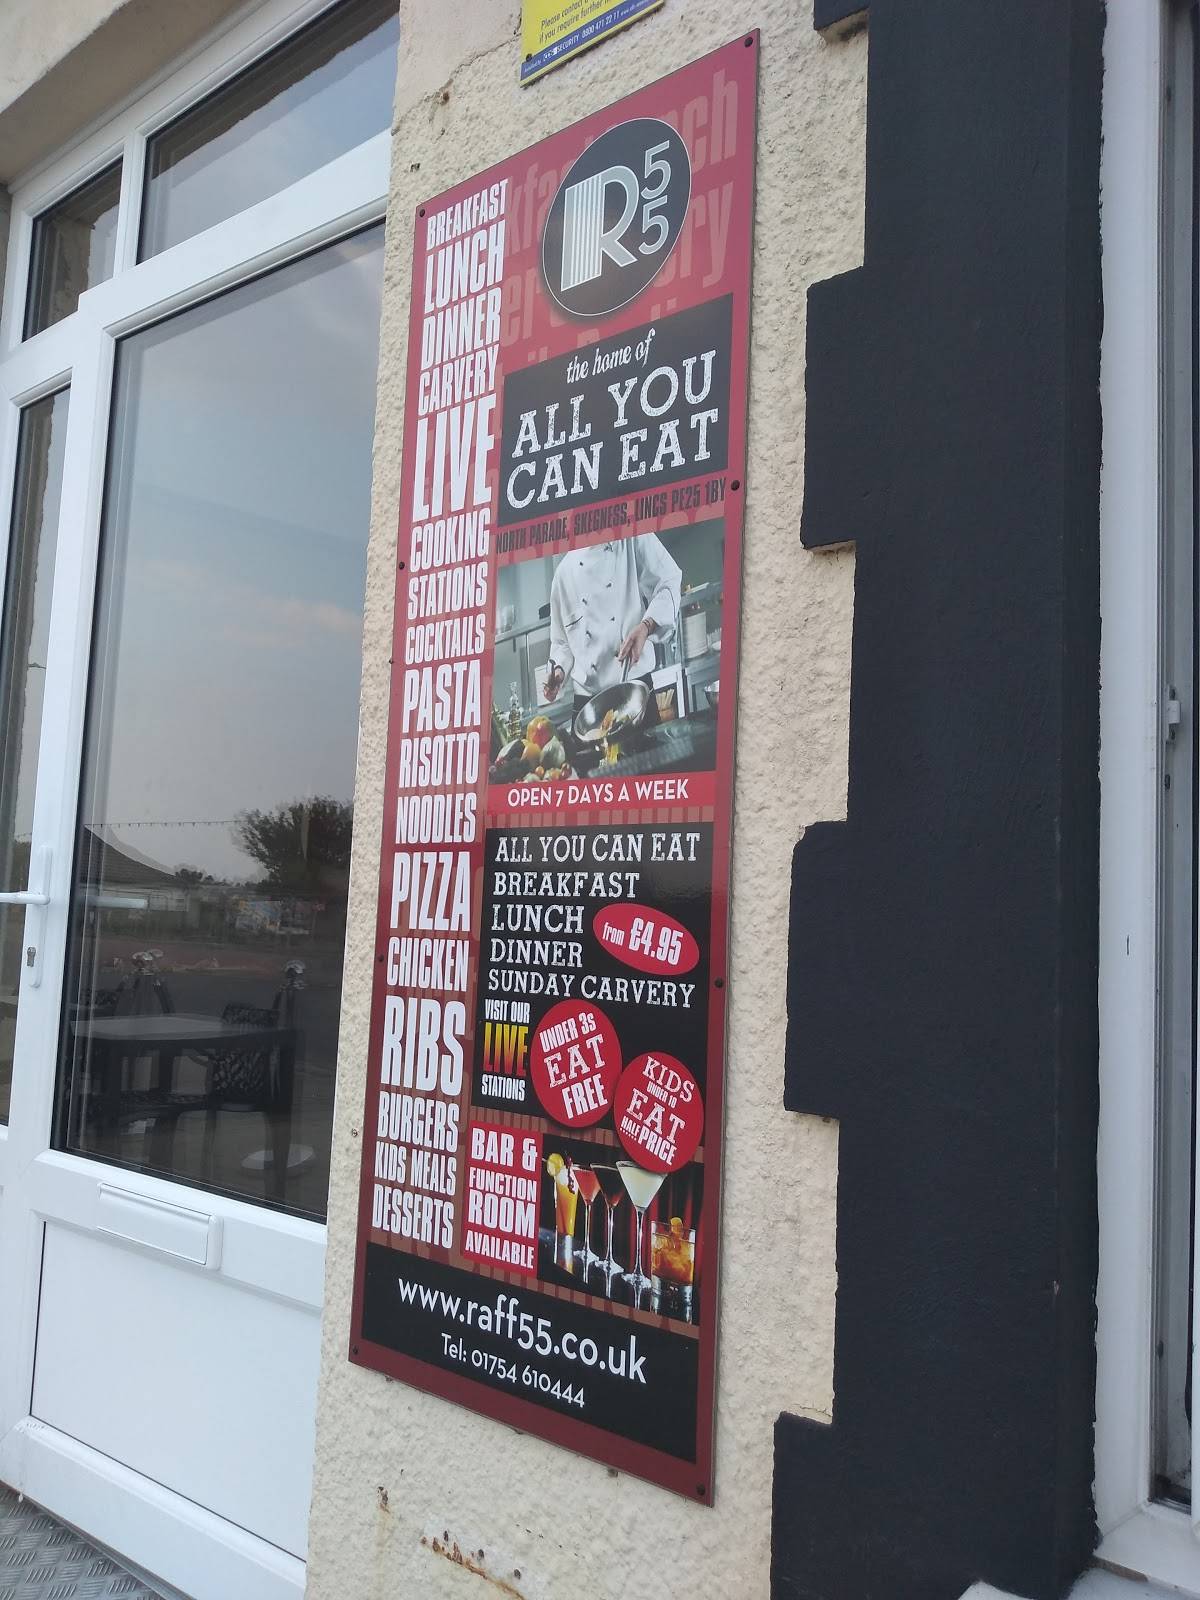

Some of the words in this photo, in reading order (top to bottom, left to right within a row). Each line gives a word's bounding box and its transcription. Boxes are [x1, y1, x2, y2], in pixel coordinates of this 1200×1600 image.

[557, 34, 580, 53] SECURITY
[426, 178, 508, 250] BREAKFAST
[424, 219, 505, 314] LUNCH
[421, 287, 502, 371] DINNER
[566, 356, 589, 384] the
[592, 346, 631, 376] home
[635, 328, 656, 368] of
[418, 343, 500, 416] CARVERY
[511, 394, 592, 458] ALL
[607, 350, 716, 428] YOU
[412, 393, 497, 522] LIVE
[506, 441, 604, 509] CAN
[618, 408, 719, 481] EAT
[410, 508, 491, 573] COOKING
[496, 526, 527, 554] NORTH
[529, 516, 570, 547] PARADE,
[574, 502, 631, 537] SKEGNESS,
[635, 492, 668, 521] LINCS
[671, 483, 701, 513] PE25
[407, 562, 488, 620] STATIONS
[405, 613, 486, 665] COCKTAILS
[402, 659, 481, 733] PASTA
[399, 731, 480, 788] RISOTTO
[395, 792, 477, 844] NOODLES
[508, 787, 552, 807] OPEN
[555, 792, 562, 807] 7
[568, 783, 614, 804] DAYS
[617, 781, 630, 802] A
[635, 779, 689, 800] WEEK
[494, 836, 533, 862] ALL
[539, 834, 587, 863] YOU
[591, 833, 644, 862] CAN
[650, 832, 700, 862] EAT
[390, 851, 471, 932] PIZZA
[493, 871, 640, 898] BREAKFAST
[491, 903, 585, 934] LUNCH
[602, 922, 625, 946] from
[628, 917, 684, 966] £4.95
[386, 936, 470, 992] CHICKEN
[490, 938, 583, 968] DINNER
[484, 998, 509, 1022] VISIT
[510, 1001, 530, 1024] OUR
[488, 968, 575, 997] SUNDAY
[580, 975, 696, 1009] CARVERY
[380, 995, 466, 1096] RIBS
[482, 1022, 529, 1077] LIVE
[539, 1017, 578, 1053] UNDER
[578, 1012, 597, 1035] 3s
[481, 1073, 526, 1101] STATIONS
[543, 1034, 605, 1088] EAT
[642, 1055, 695, 1103] KIDS
[377, 1091, 460, 1153] BURGERS
[561, 1073, 608, 1120] FREE
[626, 1087, 686, 1144] EAT
[646, 1080, 668, 1103] UNDER
[667, 1095, 678, 1109] 10
[374, 1140, 407, 1184] KIDS
[410, 1148, 457, 1196] MEALS
[471, 1127, 515, 1167] BAR
[522, 1137, 538, 1172] &
[620, 1115, 641, 1137] HALF
[637, 1124, 678, 1166] PRICE
[469, 1166, 537, 1203] FUNCTION
[372, 1183, 455, 1249] DESSERTS
[468, 1189, 536, 1239] ROOM
[465, 1229, 534, 1269] AVAILABLE
[398, 1278, 647, 1383] www.raff55.co.uk
[441, 1332, 467, 1363] Tel:
[471, 1349, 517, 1384] 01754
[522, 1365, 585, 1408] 610444
